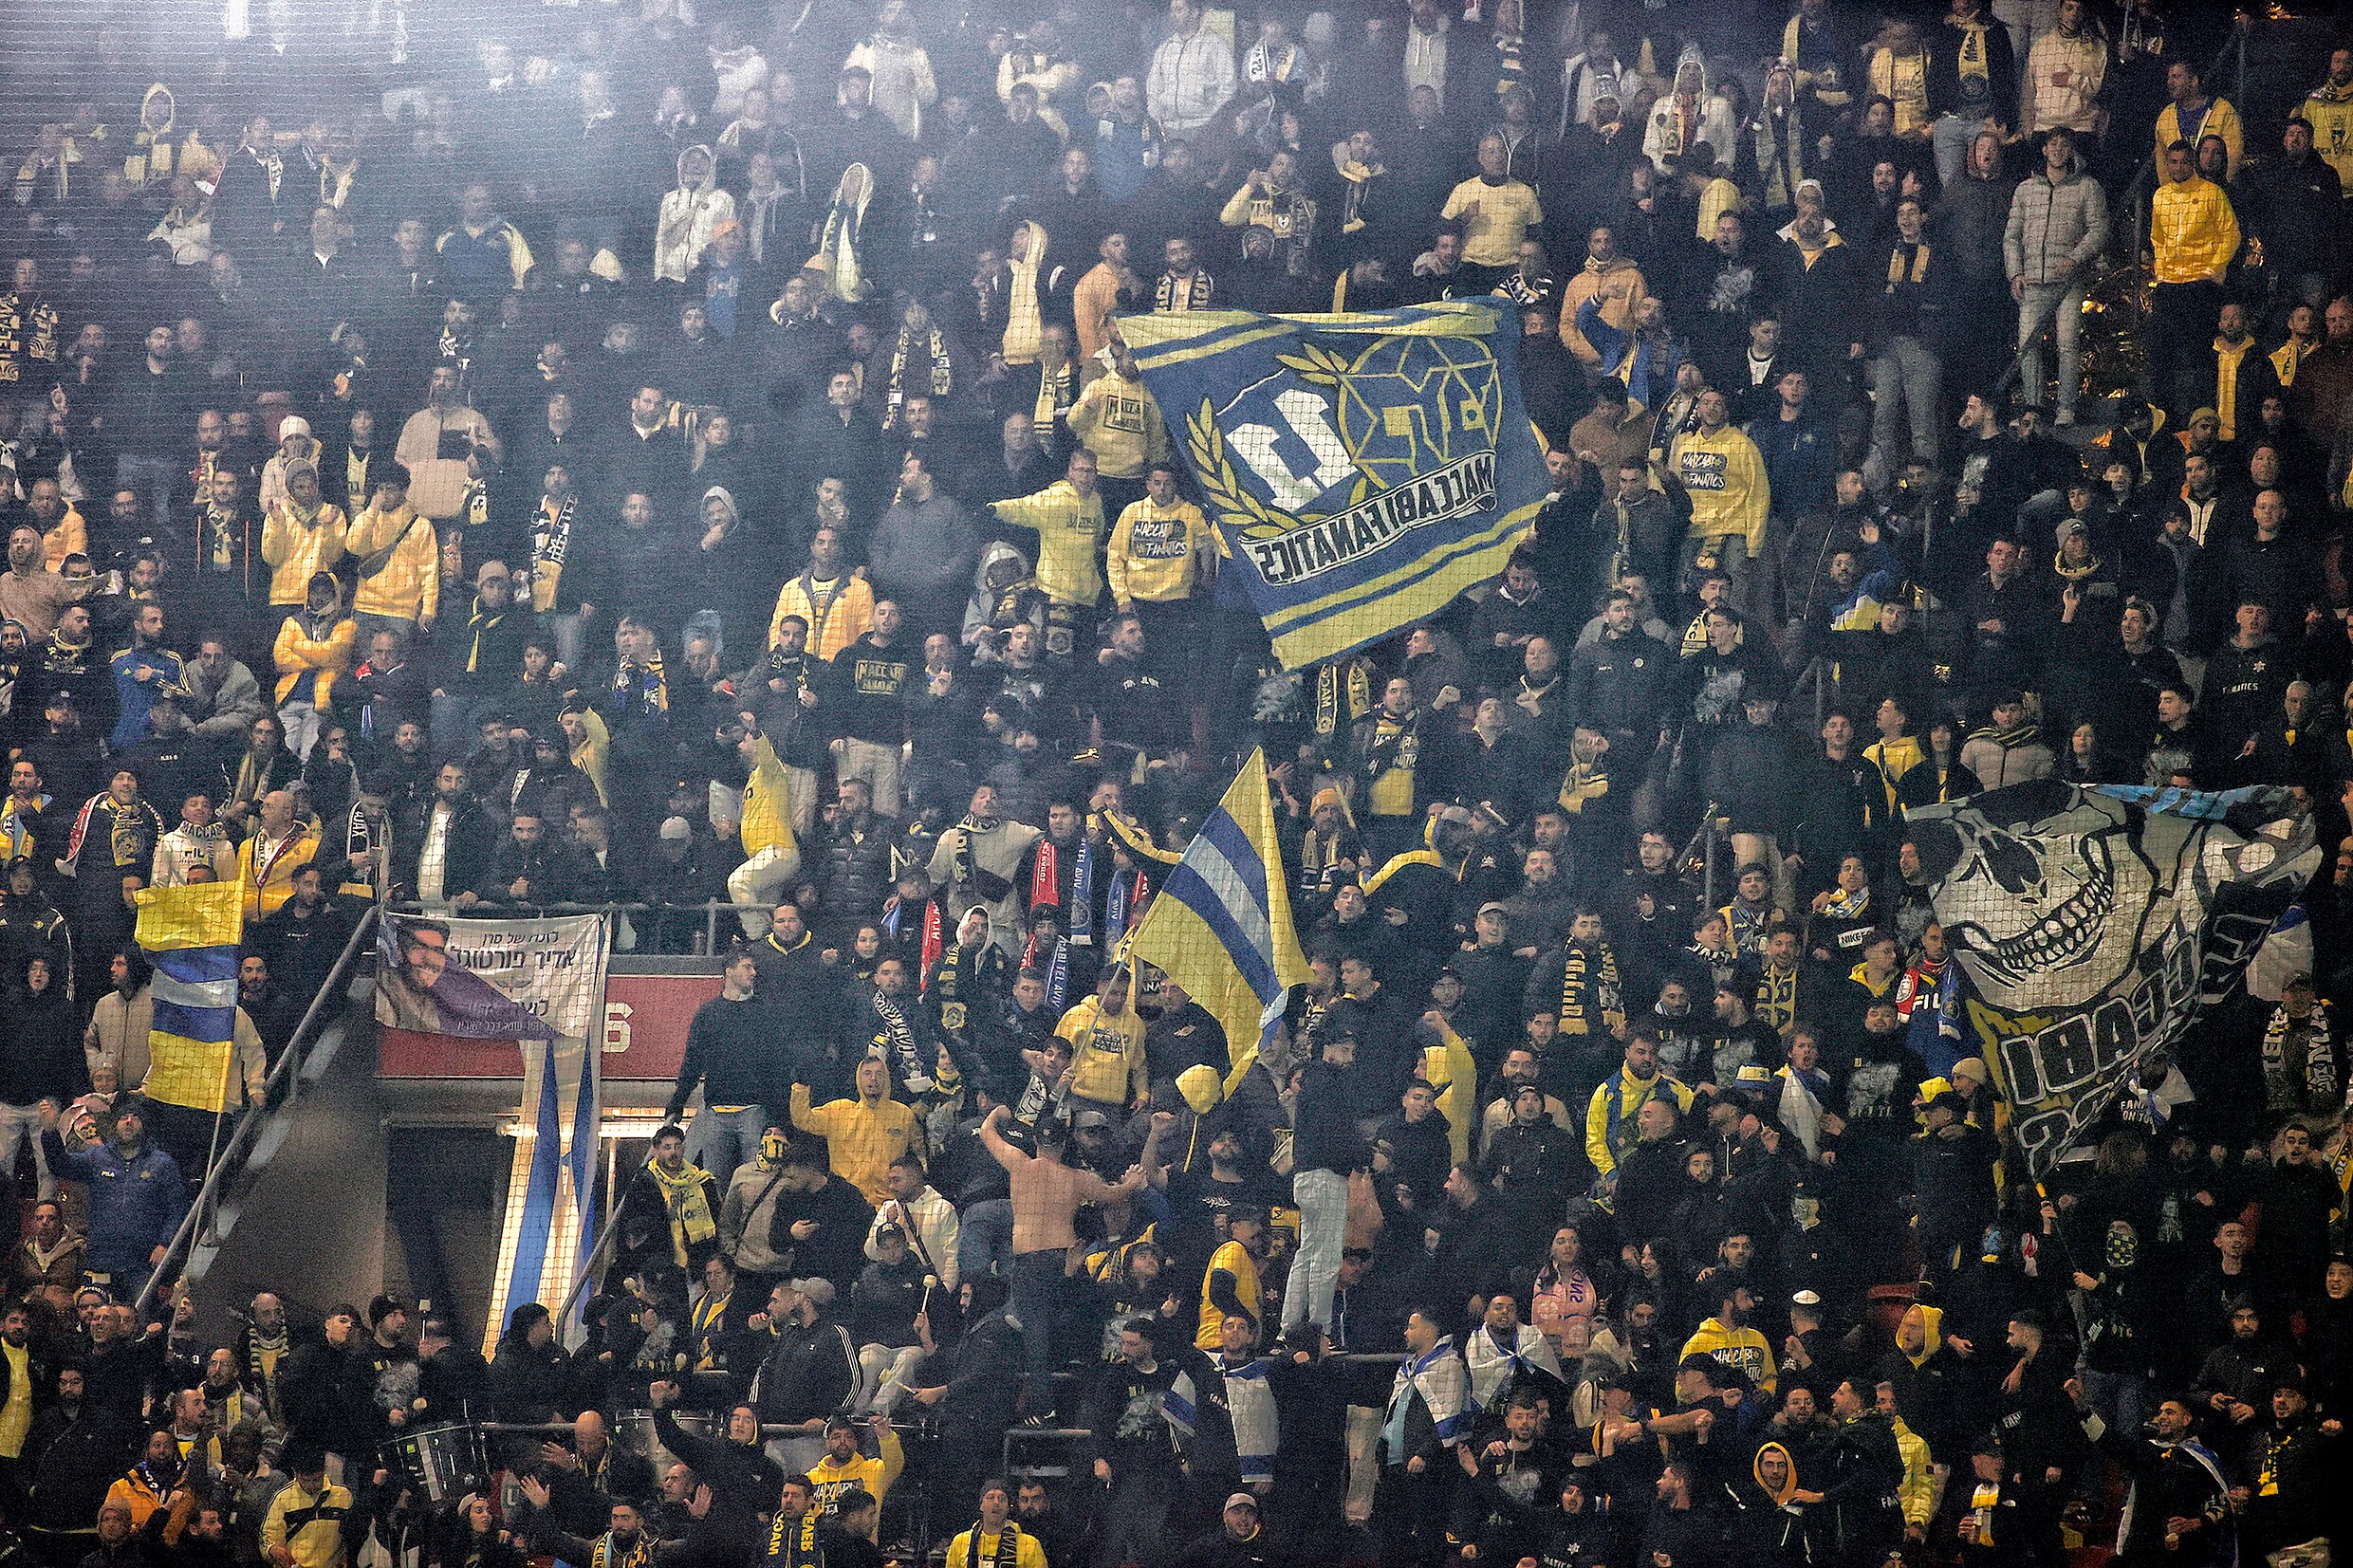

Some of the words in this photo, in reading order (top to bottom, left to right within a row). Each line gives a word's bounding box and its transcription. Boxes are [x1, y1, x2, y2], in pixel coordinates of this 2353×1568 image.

[1689, 472, 1725, 488] FANATICS
[2222, 682, 2257, 693] FNATICS
[181, 821, 222, 839] MACCAB
[184, 847, 204, 858] FIL
[1842, 930, 1862, 944] NIKE
[1056, 966, 1065, 982] TEL
[1055, 985, 1065, 1008] AVIV
[1912, 993, 1941, 1012] FIL
[2122, 1109, 2136, 1121] ON
[2138, 1113, 2154, 1125] TOU
